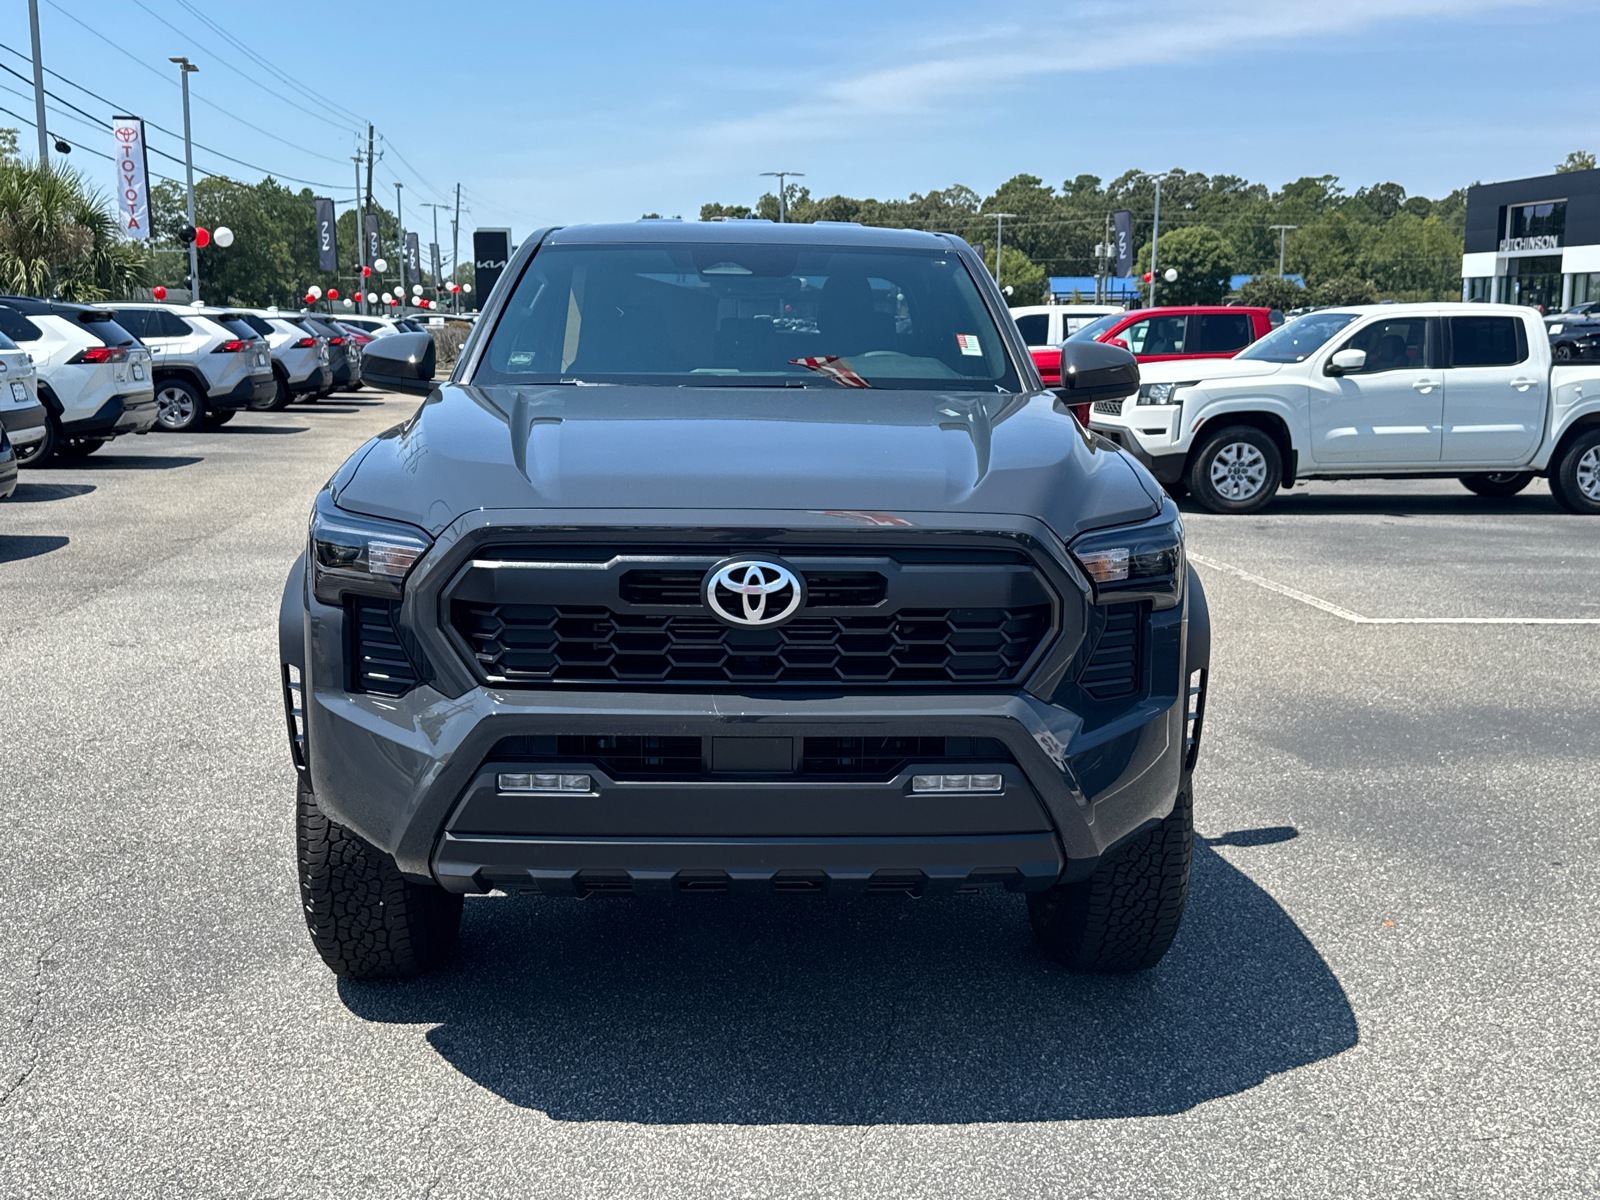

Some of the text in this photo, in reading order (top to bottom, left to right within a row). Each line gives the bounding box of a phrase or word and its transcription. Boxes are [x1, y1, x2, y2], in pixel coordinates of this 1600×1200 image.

[121, 145, 140, 230] TOYOTA
[1500, 235, 1558, 252] HUTCHINSON
[476, 259, 507, 269] KIA
